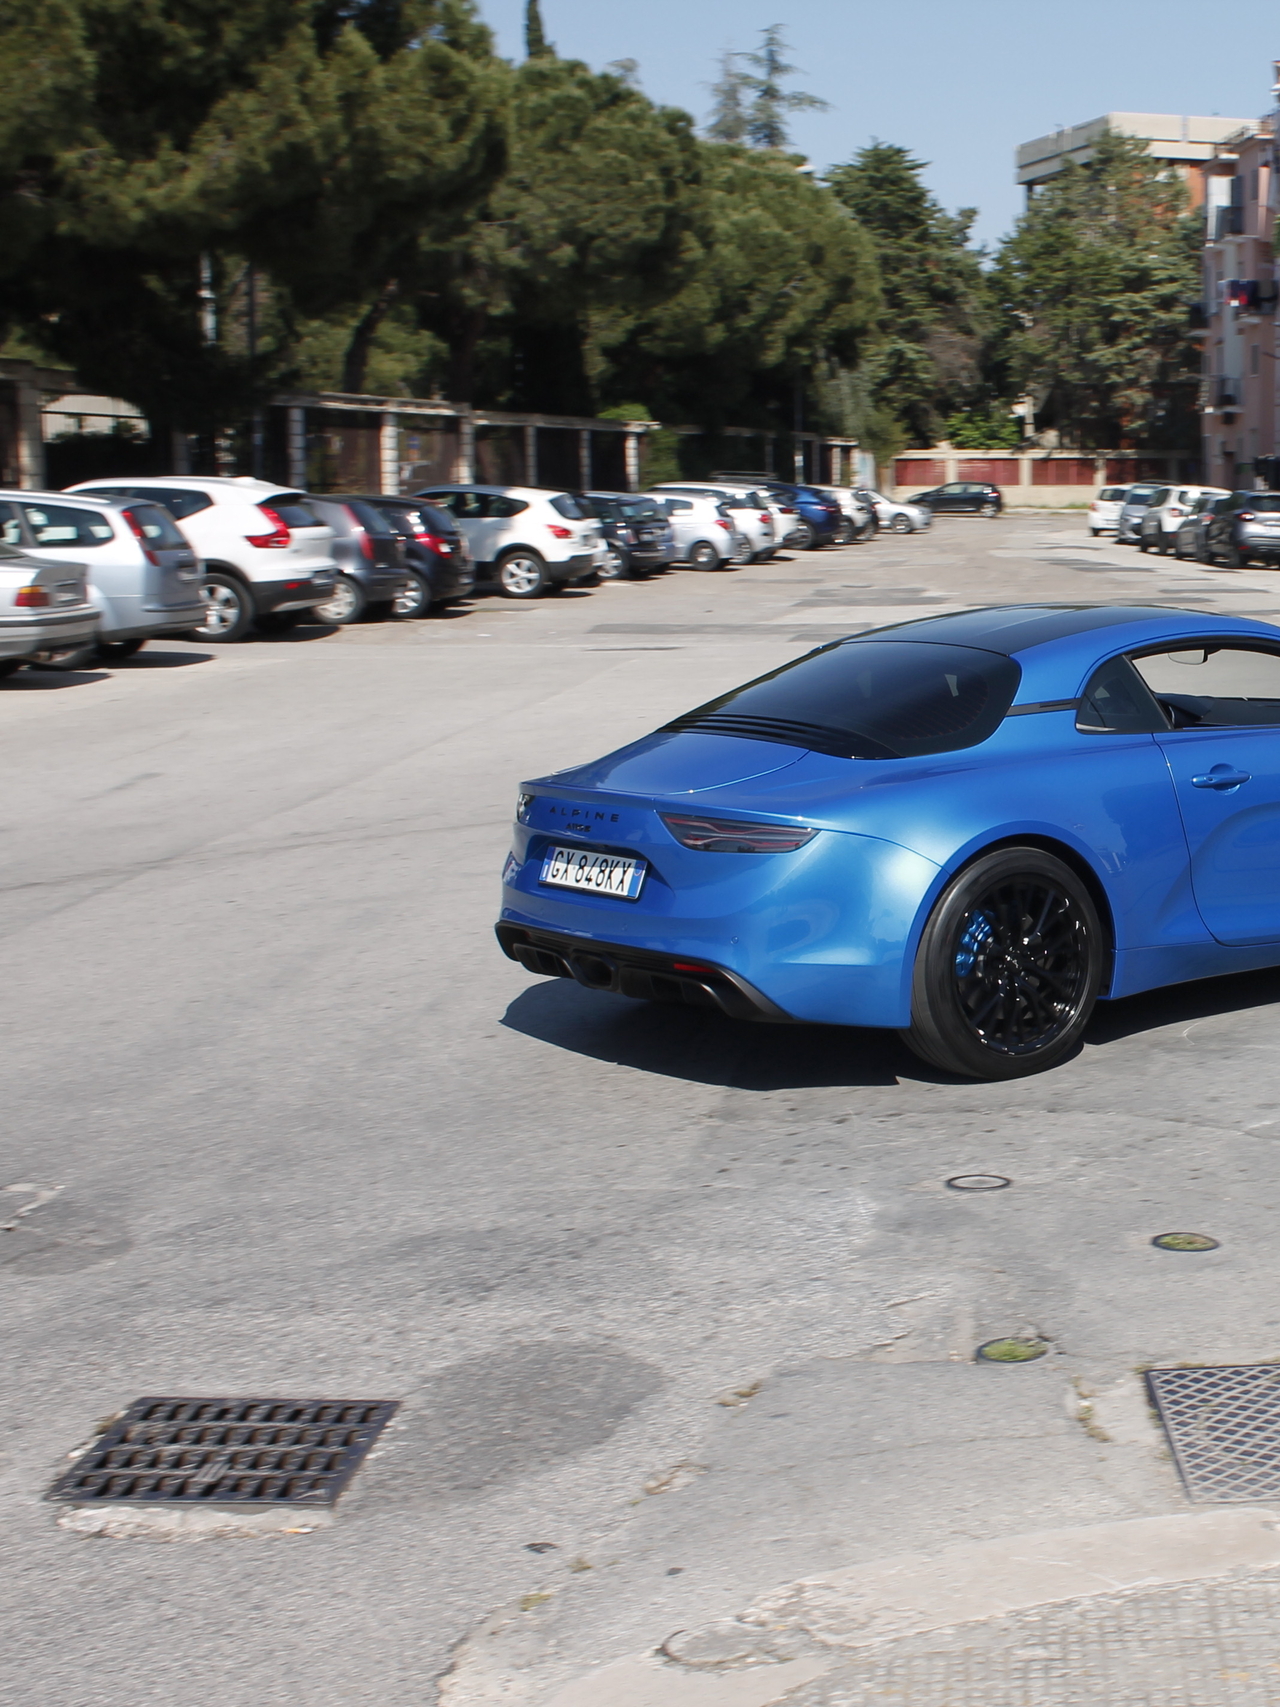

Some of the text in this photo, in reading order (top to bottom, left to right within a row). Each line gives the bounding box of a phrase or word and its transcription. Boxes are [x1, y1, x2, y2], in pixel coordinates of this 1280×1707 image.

[549, 806, 620, 823] ALPINE
[551, 850, 632, 892] GX 848KX
